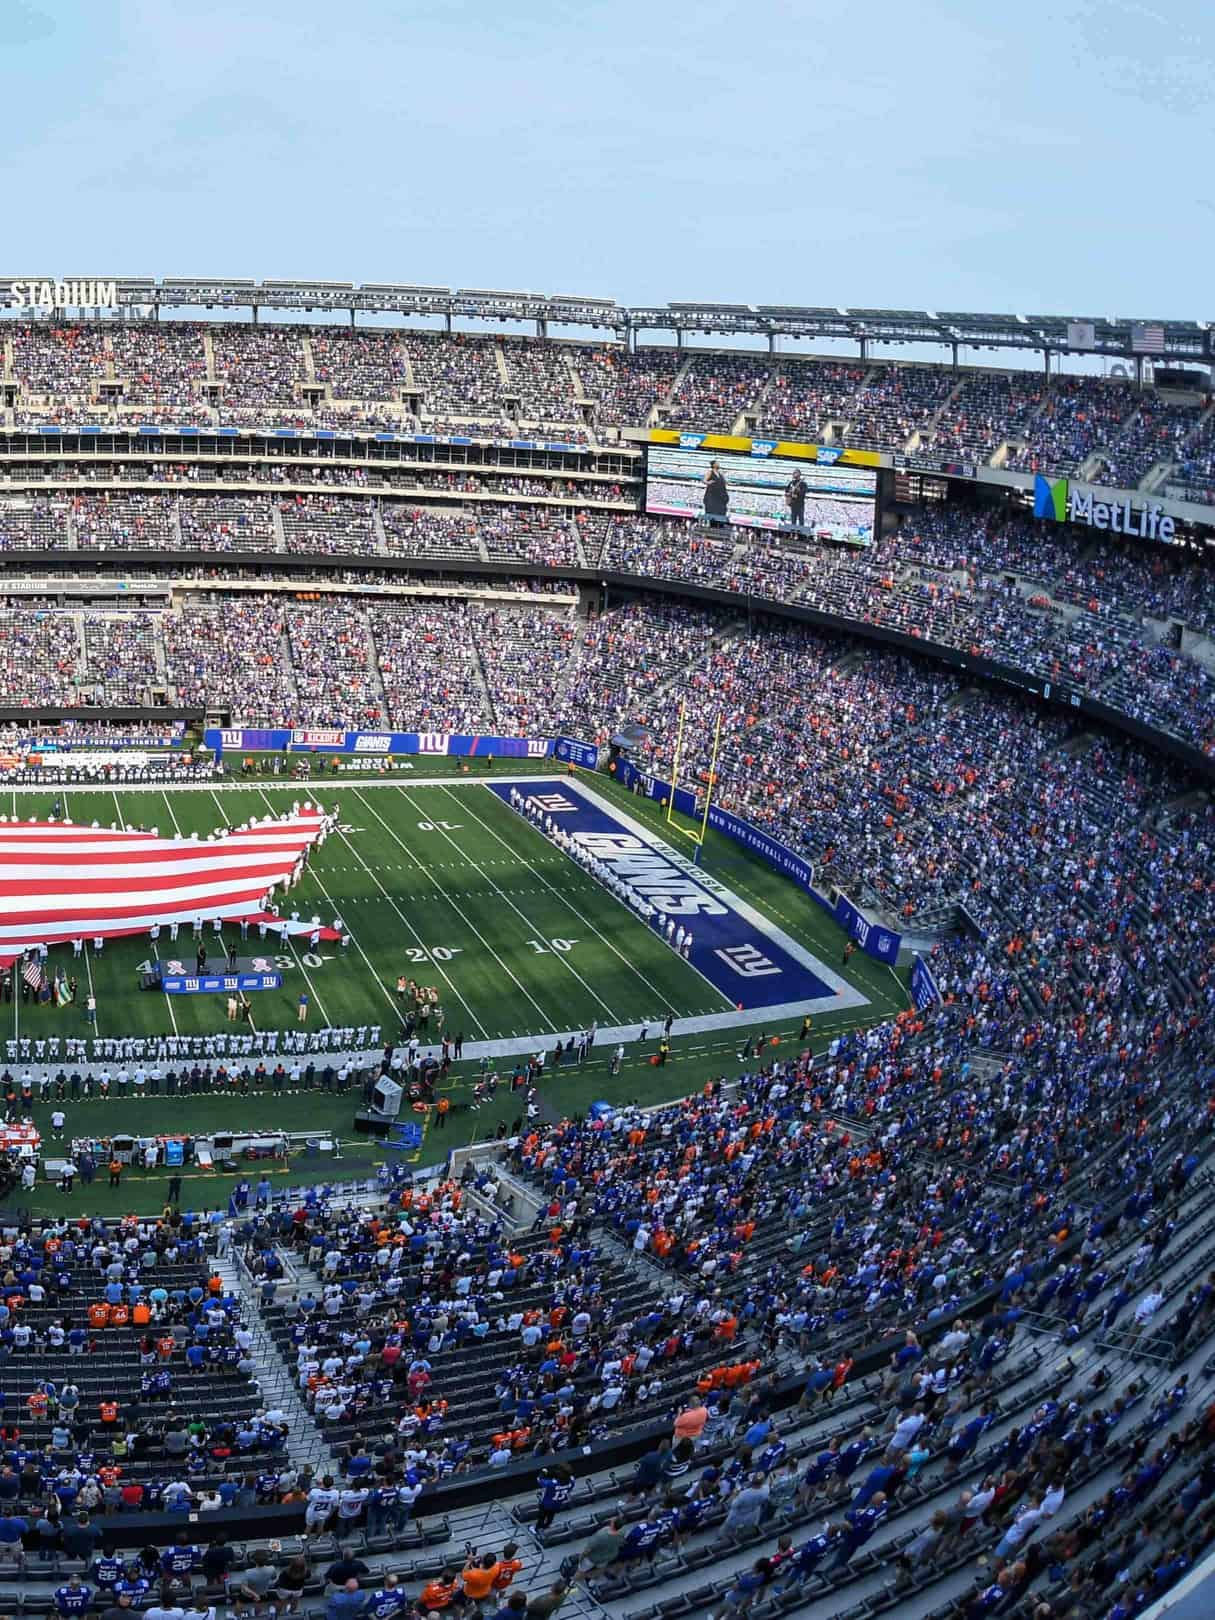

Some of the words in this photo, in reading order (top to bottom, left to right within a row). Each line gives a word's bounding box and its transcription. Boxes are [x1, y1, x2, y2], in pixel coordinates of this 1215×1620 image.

[7, 281, 117, 308] STADIUM
[680, 436, 702, 448] SAP
[751, 443, 773, 455] SAP
[817, 451, 840, 463] SAP
[1070, 489, 1176, 544] MetLife
[220, 731, 242, 748] ny
[307, 732, 340, 744] KICKOFF
[354, 735, 392, 752] GIANTS
[417, 733, 450, 756] ny
[527, 740, 548, 758] ny
[709, 811, 725, 826] NEW
[727, 822, 746, 838] YORK
[747, 834, 782, 862] FOOTBALL
[783, 858, 808, 881] GIANTS
[570, 832, 729, 915] GIANTS
[650, 841, 677, 856] END
[674, 860, 726, 893] RACISM
[527, 936, 573, 955] 10
[274, 952, 324, 969] 30
[405, 946, 455, 964] 20
